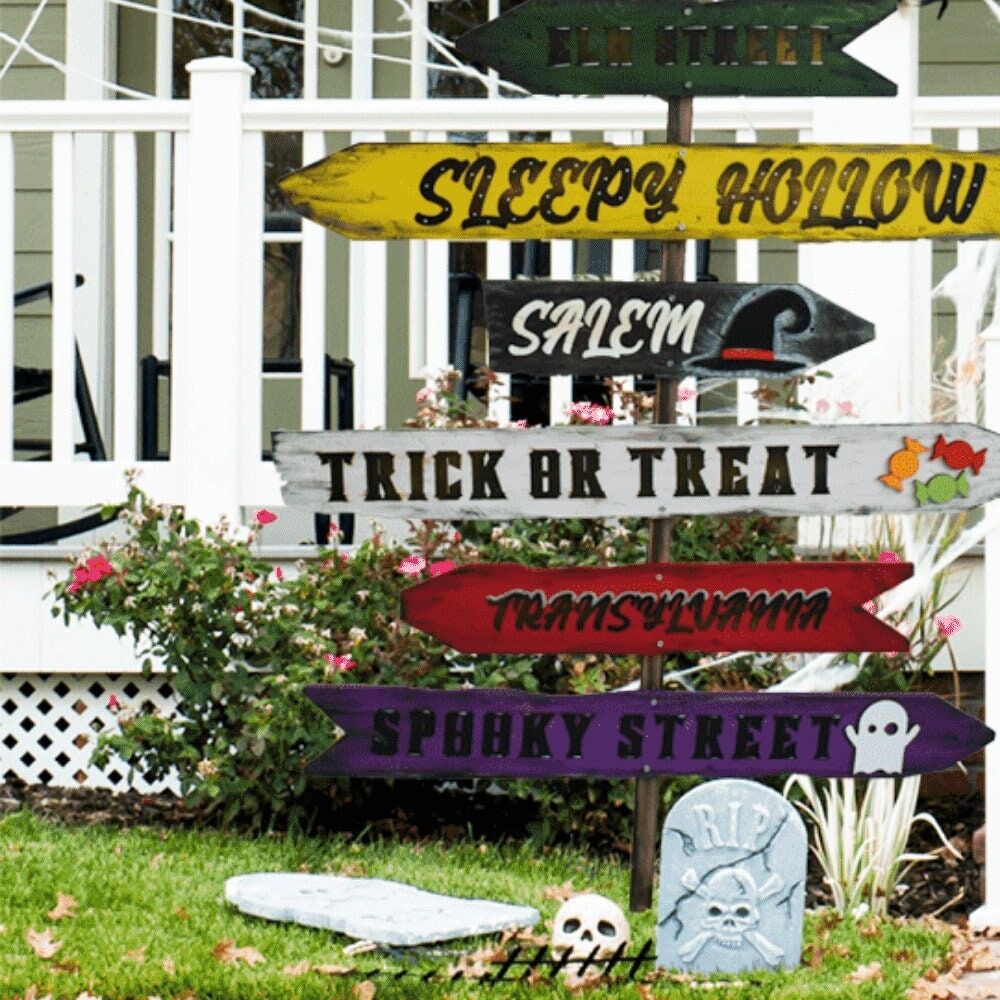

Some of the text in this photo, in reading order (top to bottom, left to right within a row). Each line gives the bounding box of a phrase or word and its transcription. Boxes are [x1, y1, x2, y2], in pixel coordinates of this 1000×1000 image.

[546, 25, 829, 67] ELM STREET
[414, 156, 987, 230] SLEEPY HOLLOW
[507, 298, 703, 358] SALEM
[318, 444, 840, 502] TRICK OR TREAT
[486, 588, 831, 636] TRANSYLVANIA
[368, 708, 846, 760] SPOOKY STREET
[693, 803, 771, 849] RIP
